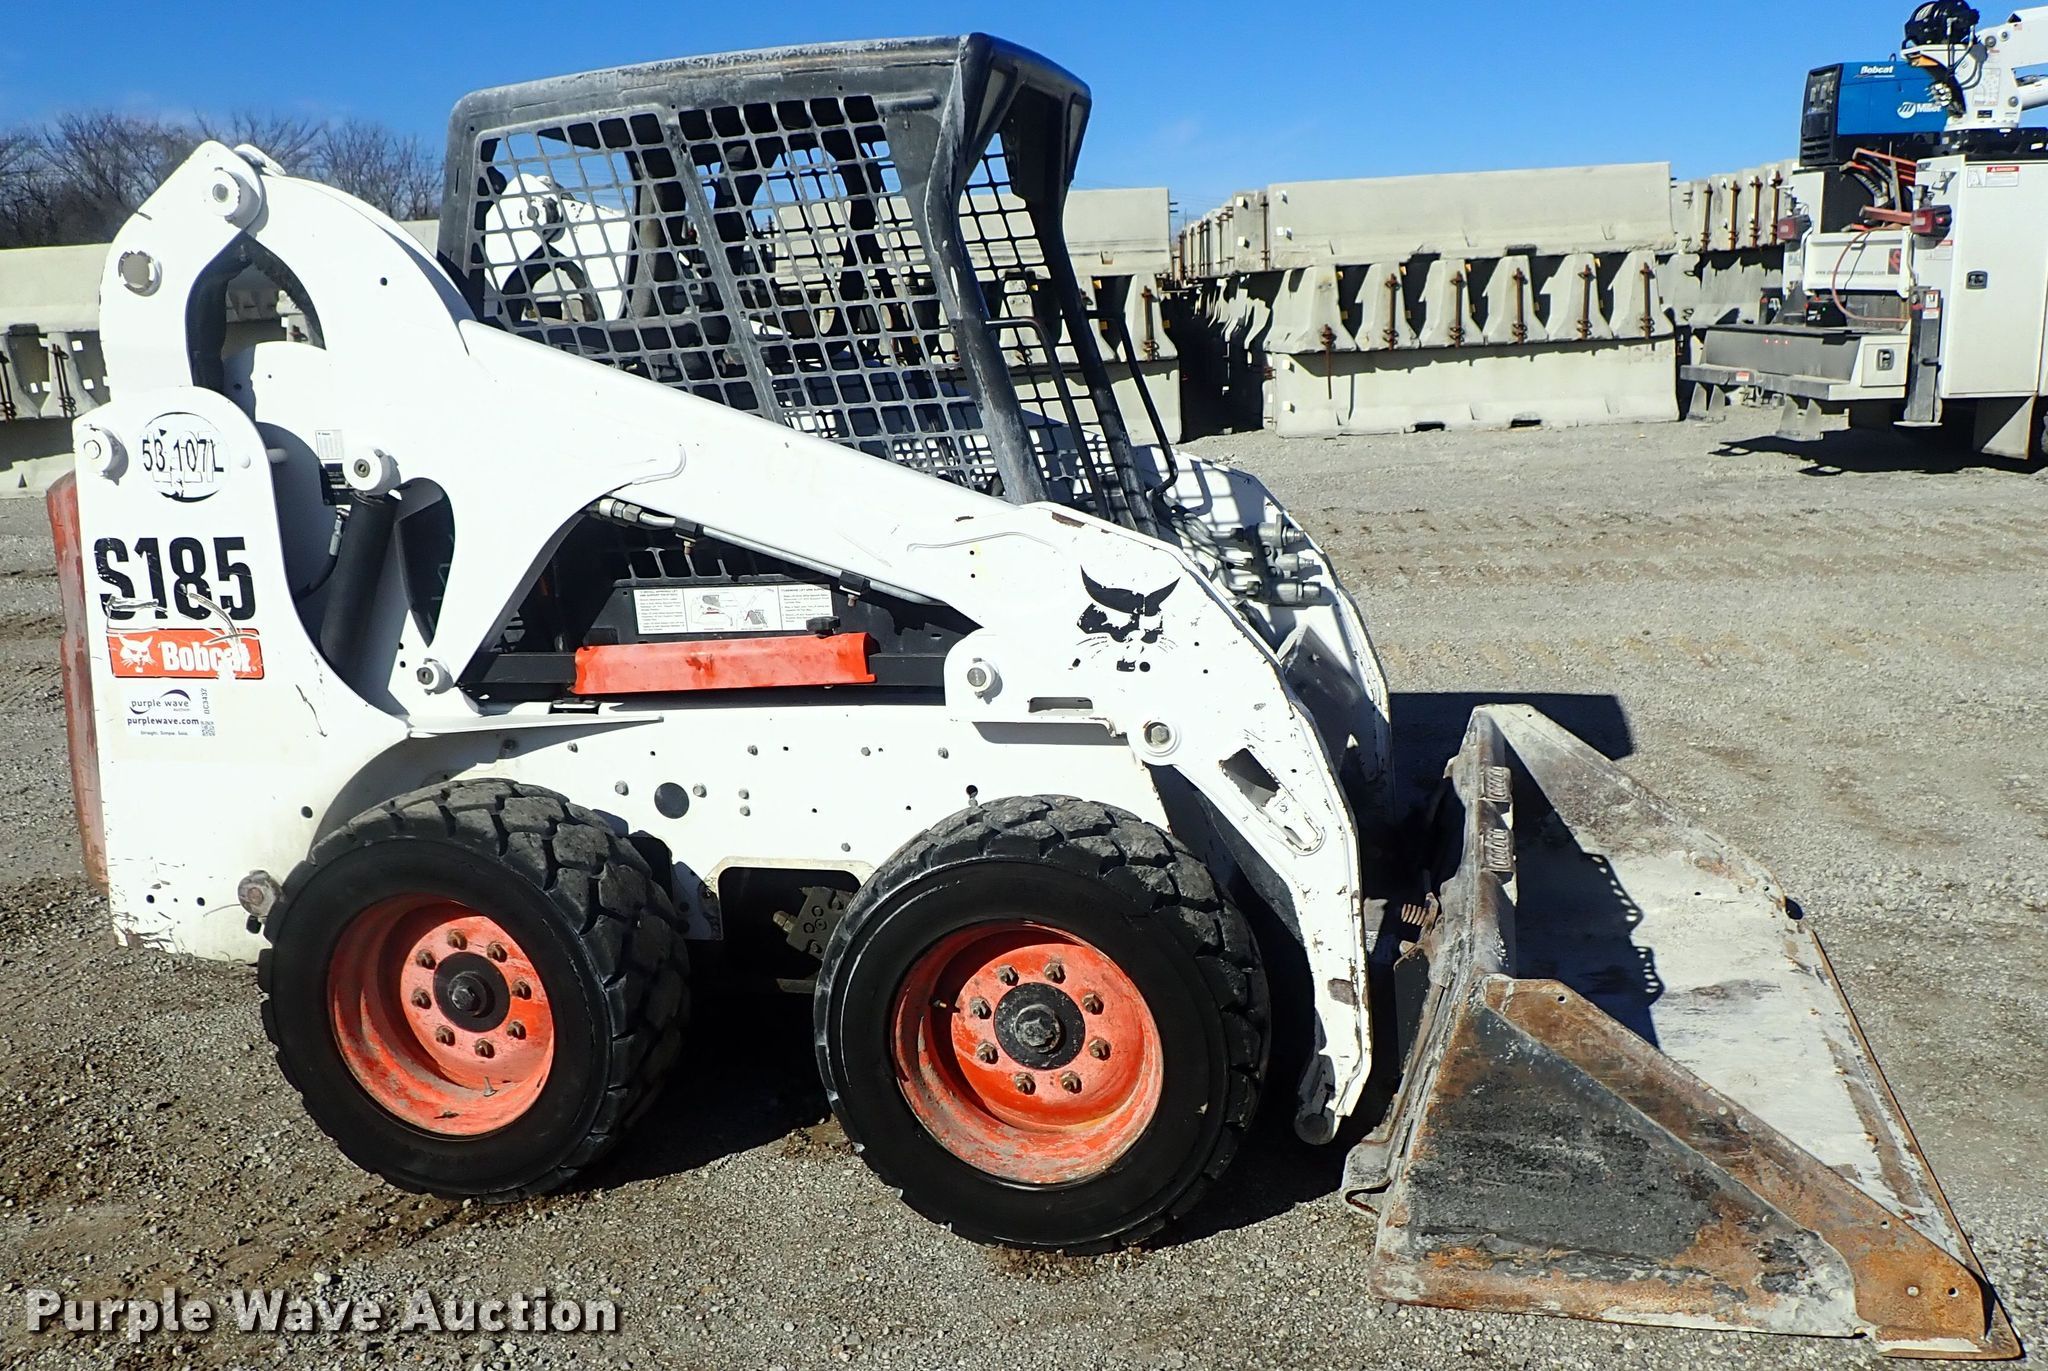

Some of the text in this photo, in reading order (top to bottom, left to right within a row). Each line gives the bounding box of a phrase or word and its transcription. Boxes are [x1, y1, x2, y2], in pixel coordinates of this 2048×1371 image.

[1860, 65, 1895, 75] Bobcat
[94, 536, 256, 620] S185
[131, 699, 161, 708] purple
[127, 716, 199, 726] purplewave.com
